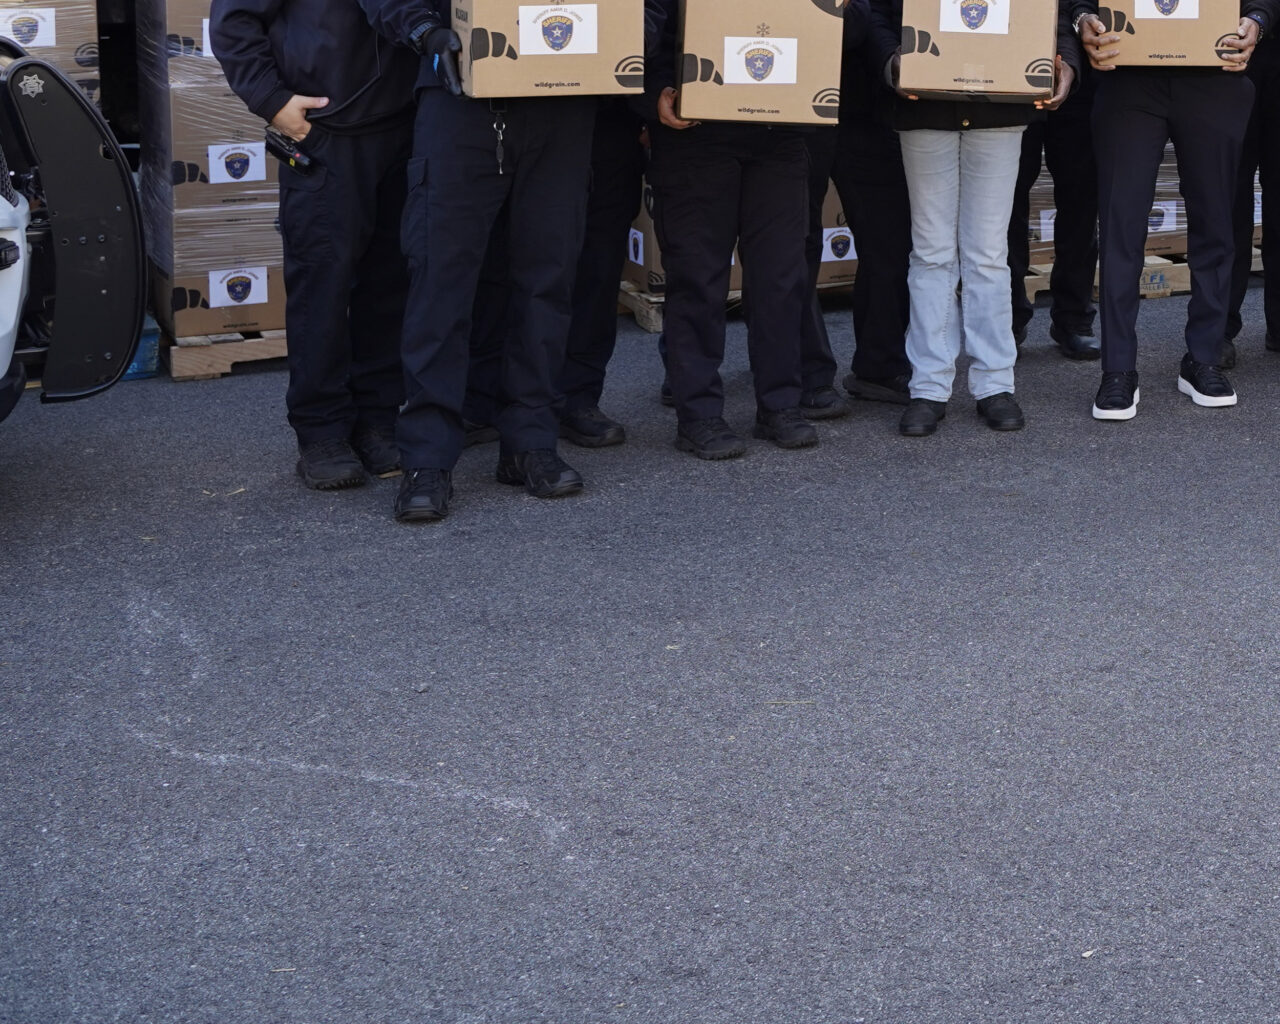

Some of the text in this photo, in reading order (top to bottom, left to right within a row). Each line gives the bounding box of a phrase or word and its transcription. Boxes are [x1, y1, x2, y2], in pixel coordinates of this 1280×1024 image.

[532, 8, 550, 25] SHERIFF
[568, 10, 584, 23] JONES
[542, 15, 573, 28] SHERIFF
[736, 41, 752, 56] SHERIFF
[770, 44, 783, 56] JONES
[745, 48, 774, 59] SHERIFF
[533, 80, 581, 89] wildgrain.com
[737, 107, 780, 115] wildgrain.com
